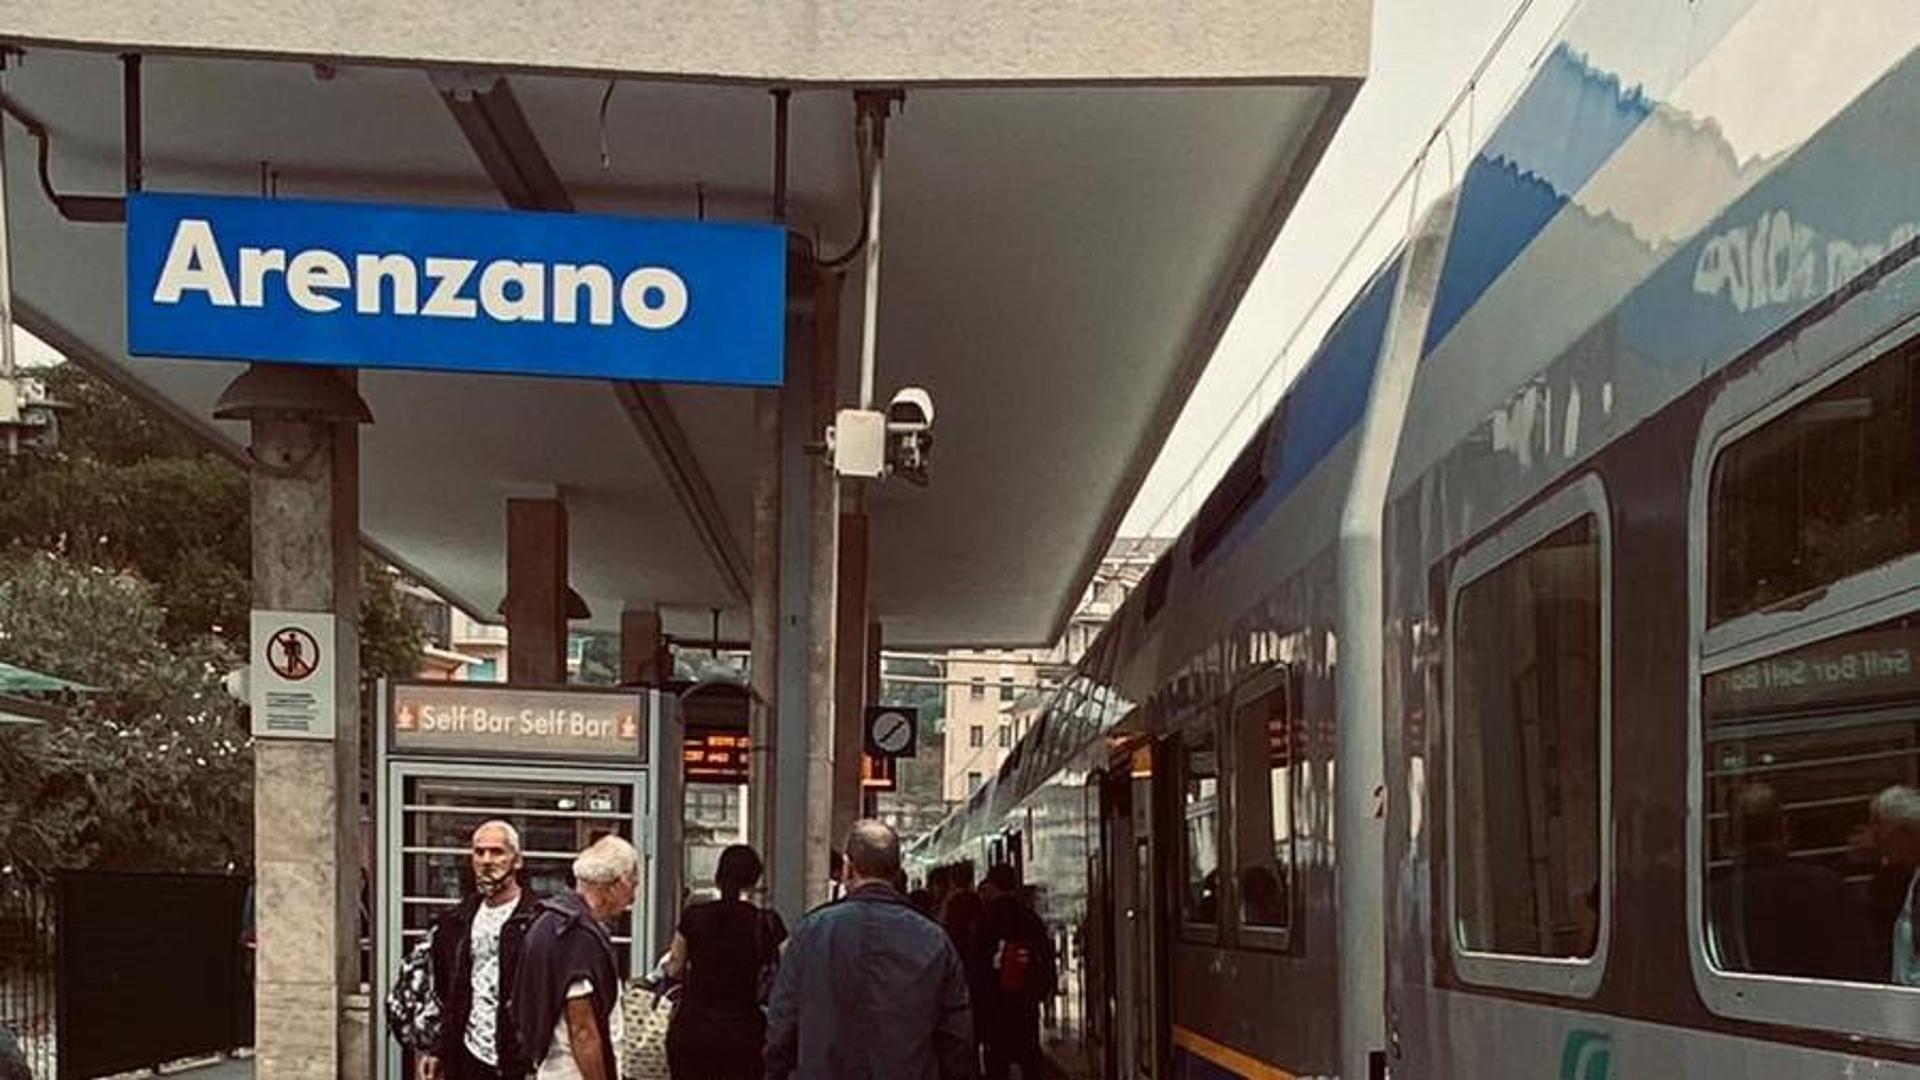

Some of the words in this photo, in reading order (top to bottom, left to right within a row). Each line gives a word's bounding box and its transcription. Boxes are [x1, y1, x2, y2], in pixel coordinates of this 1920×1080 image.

[153, 219, 688, 330] Arenzano
[421, 705, 467, 732] Self
[472, 708, 515, 733] Bar
[519, 708, 566, 736] Self
[570, 712, 612, 738] Bar
